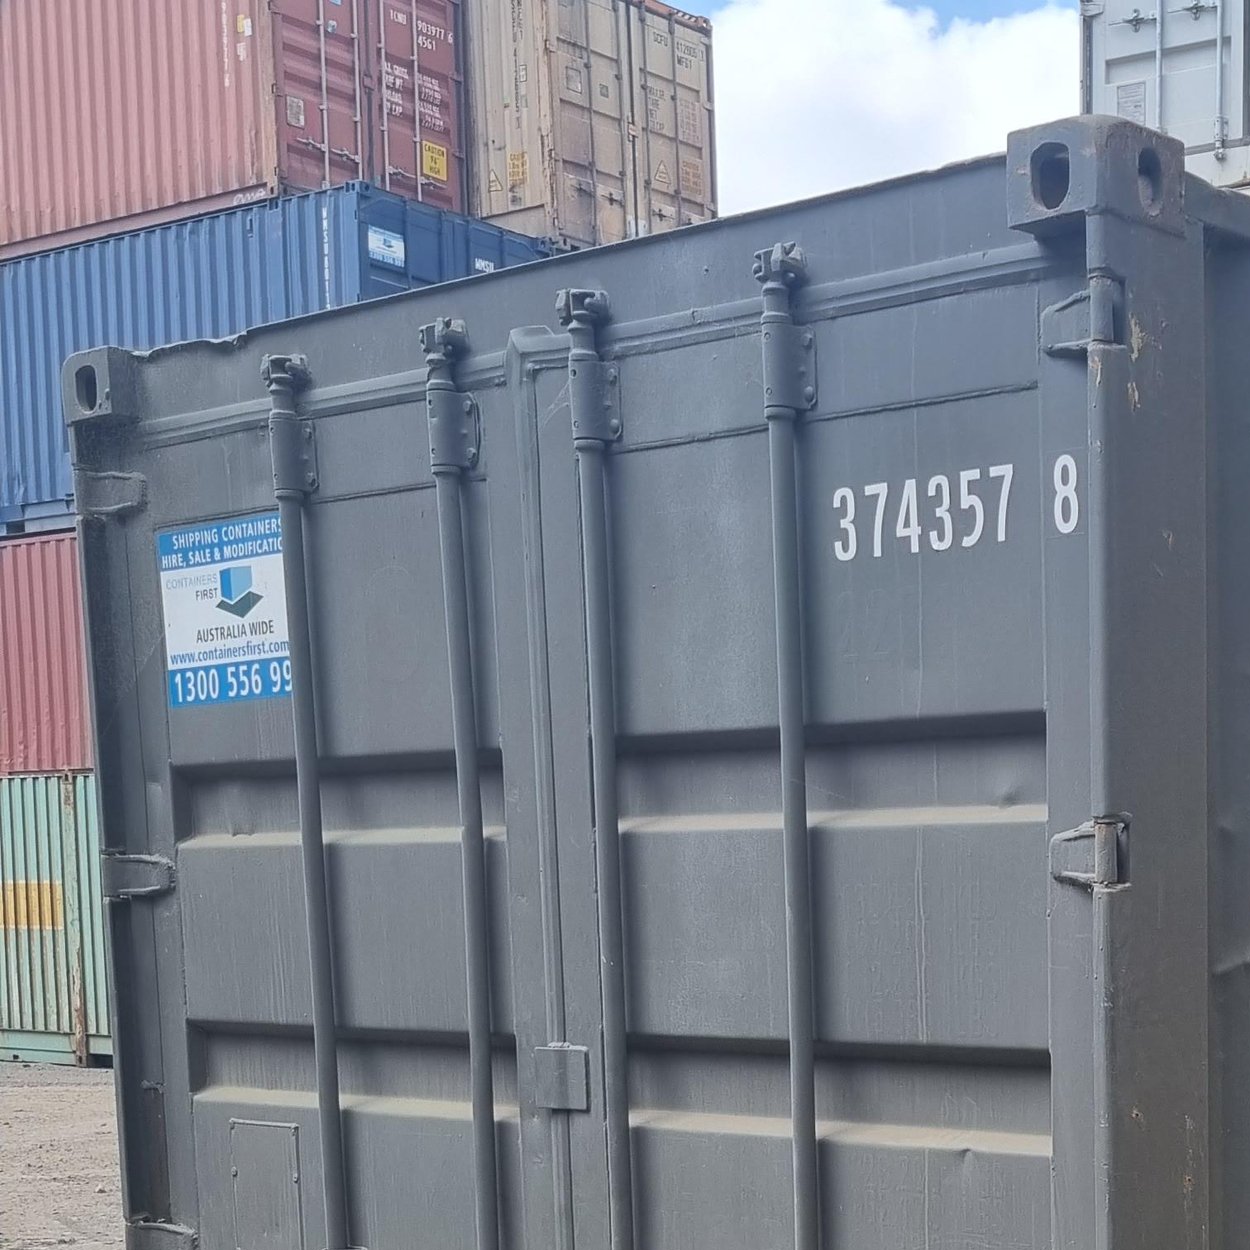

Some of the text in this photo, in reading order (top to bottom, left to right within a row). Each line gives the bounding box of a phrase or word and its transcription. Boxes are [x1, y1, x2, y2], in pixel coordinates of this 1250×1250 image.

[832, 454, 1079, 562] 374357 8
[172, 529, 218, 550] SHIPPING
[161, 553, 187, 569] HIRE,
[188, 551, 211, 565] SALE
[213, 549, 221, 561] &
[165, 574, 218, 590] CONTAINERS
[195, 587, 219, 601] FIRST
[196, 619, 275, 644] AUSTRALIA WIDE
[174, 668, 220, 703] 1300
[227, 663, 262, 698] 556
